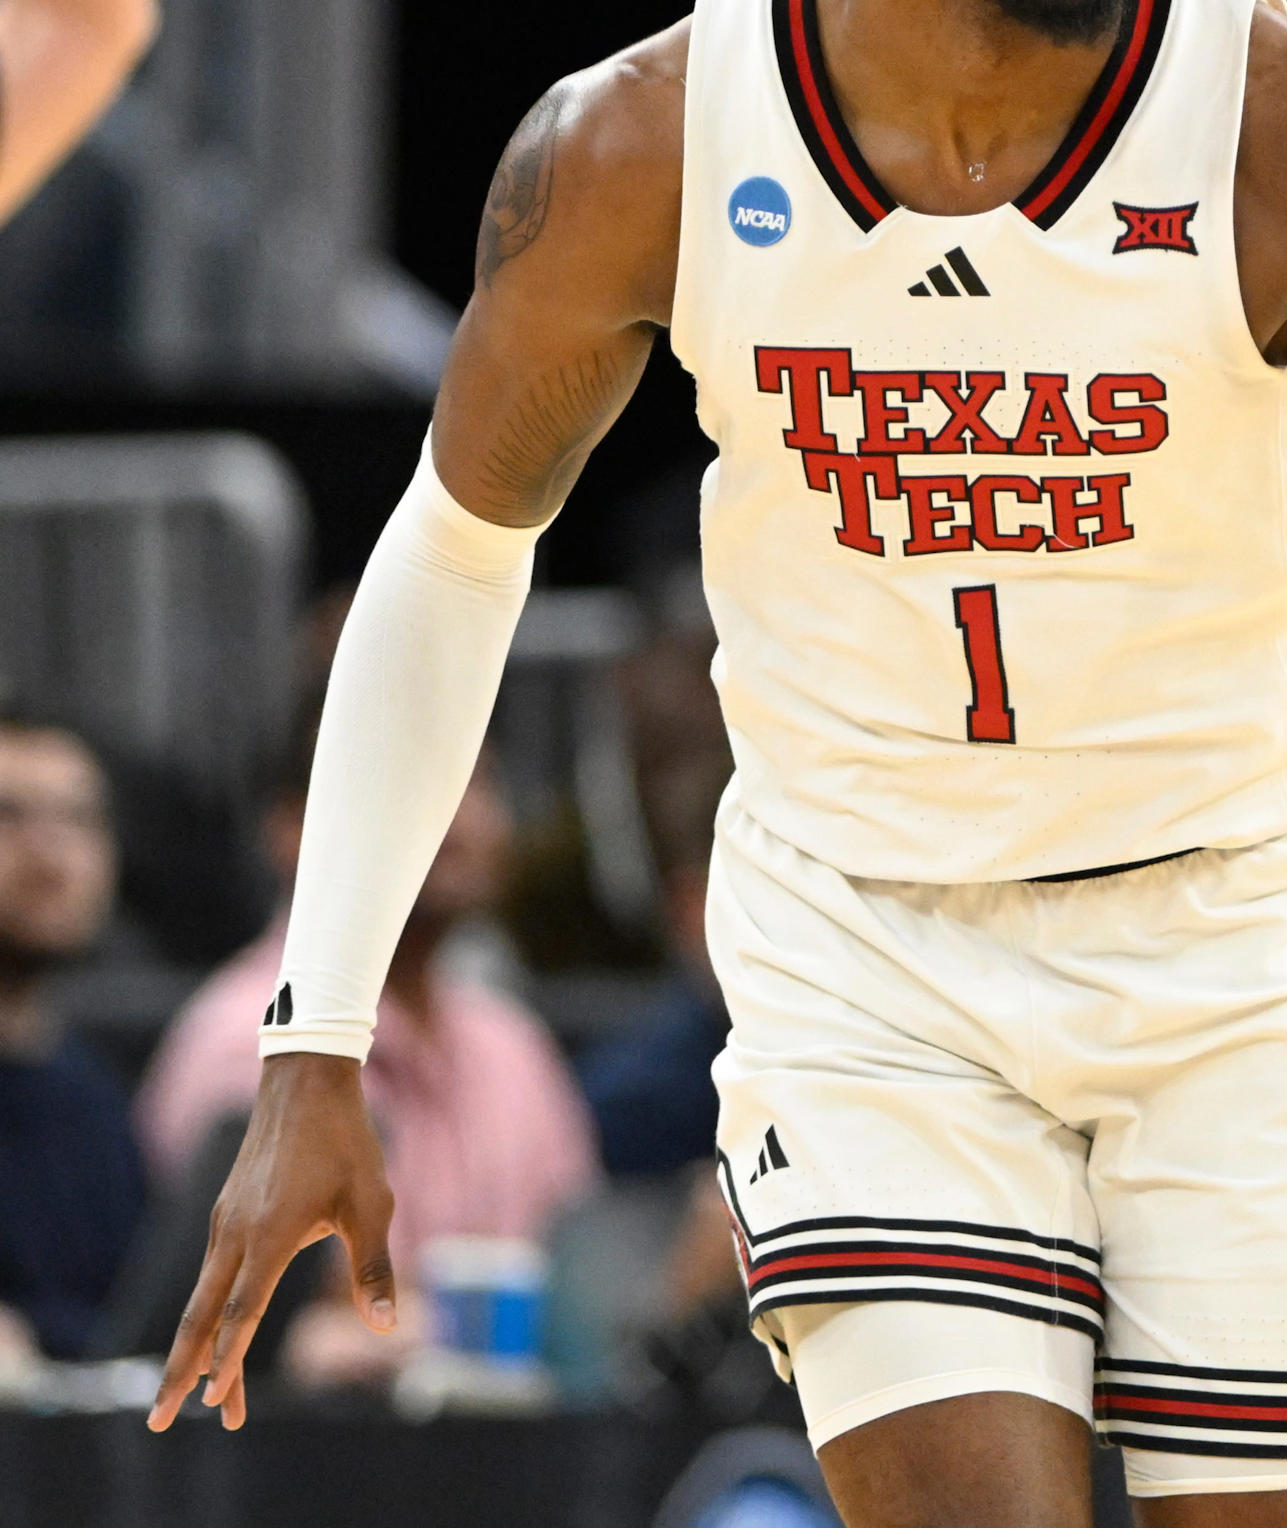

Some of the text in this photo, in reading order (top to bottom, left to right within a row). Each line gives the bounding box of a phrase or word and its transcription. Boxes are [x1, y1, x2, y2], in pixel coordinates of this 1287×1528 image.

[734, 206, 787, 232] NCAA
[1115, 203, 1195, 252] XII
[754, 345, 1169, 457] TEXAS
[801, 451, 1135, 558] TECH
[951, 583, 1016, 745] 1
